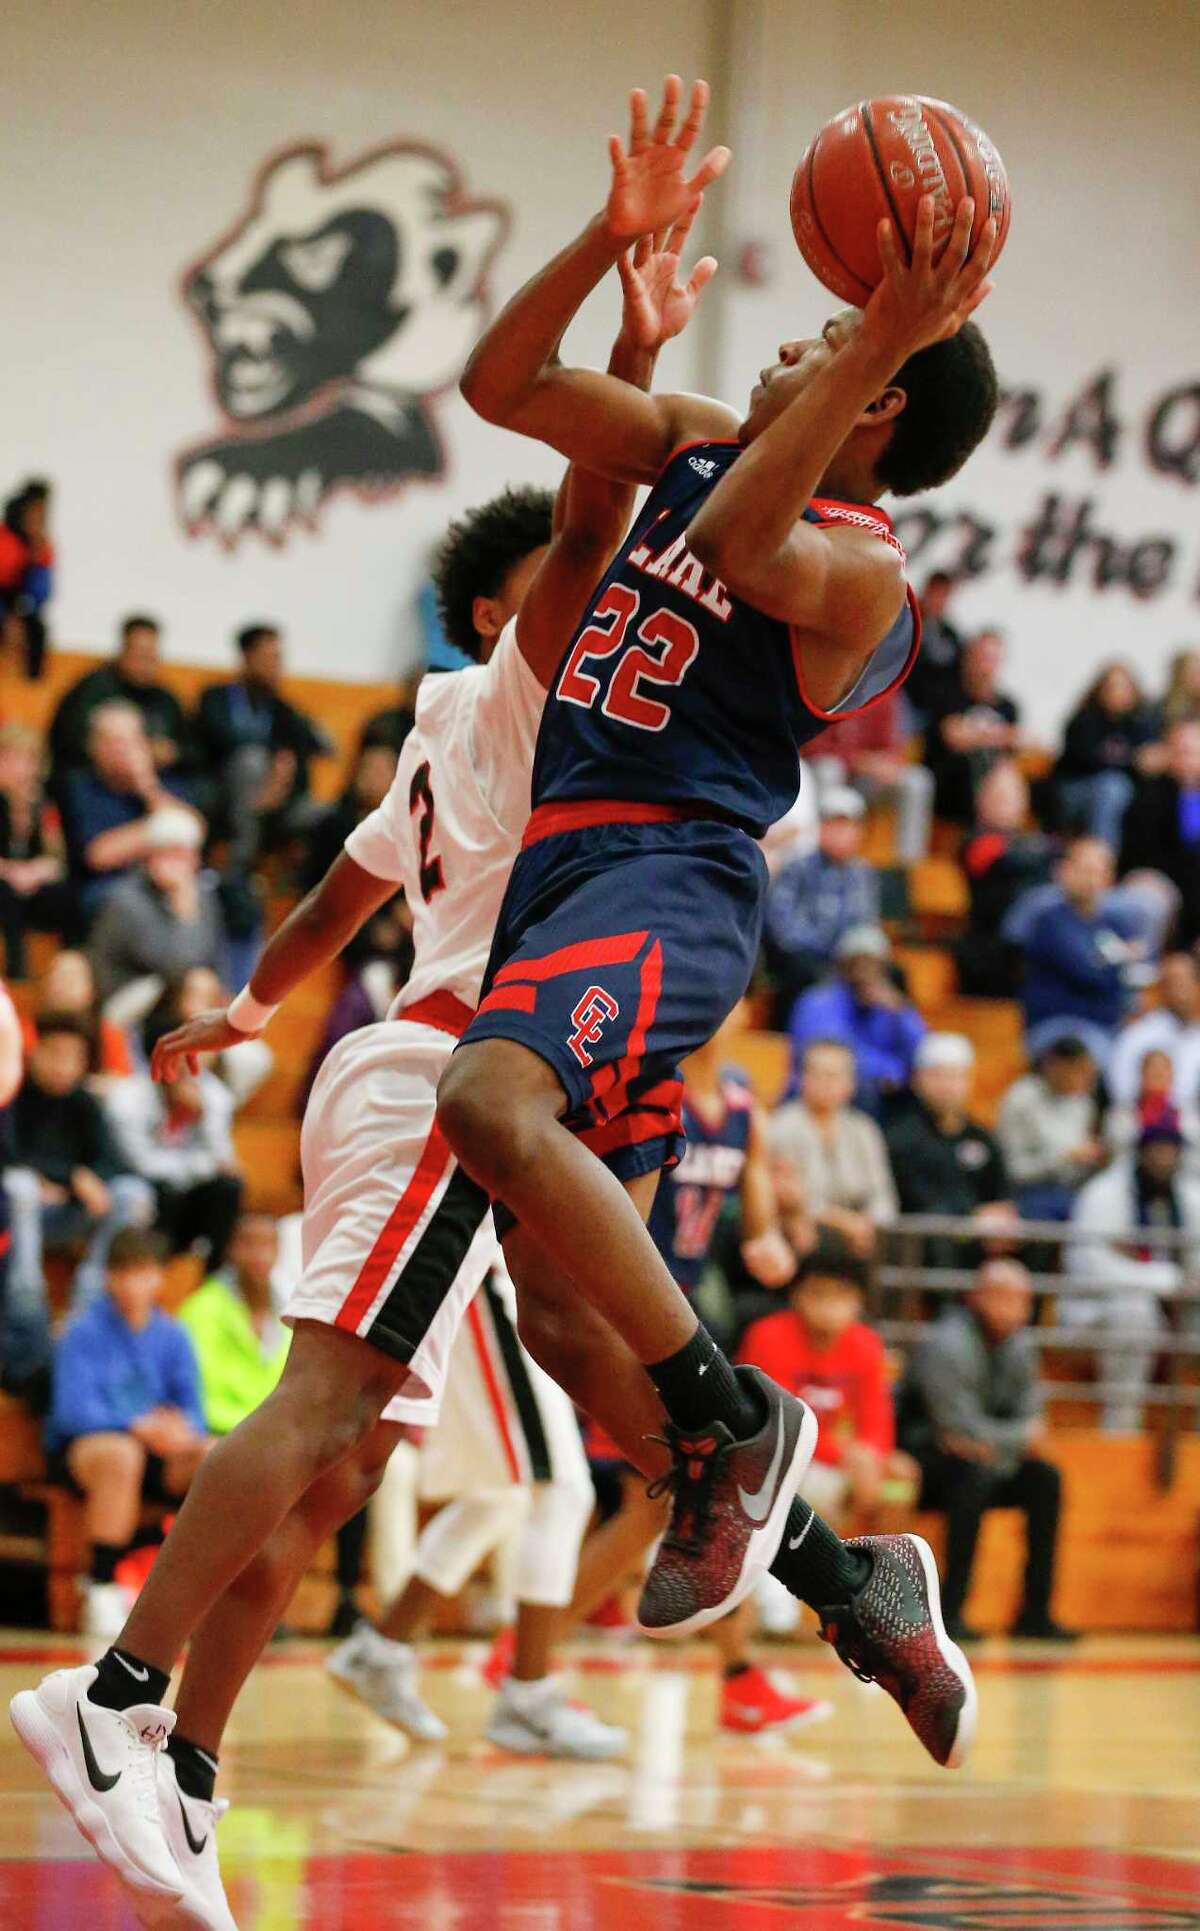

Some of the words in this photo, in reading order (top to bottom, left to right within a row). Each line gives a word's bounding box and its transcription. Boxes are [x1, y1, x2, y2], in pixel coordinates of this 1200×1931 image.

[1045, 364, 1120, 472] A
[1016, 492, 1179, 604] the
[555, 582, 700, 732] 22
[408, 758, 447, 906] 2
